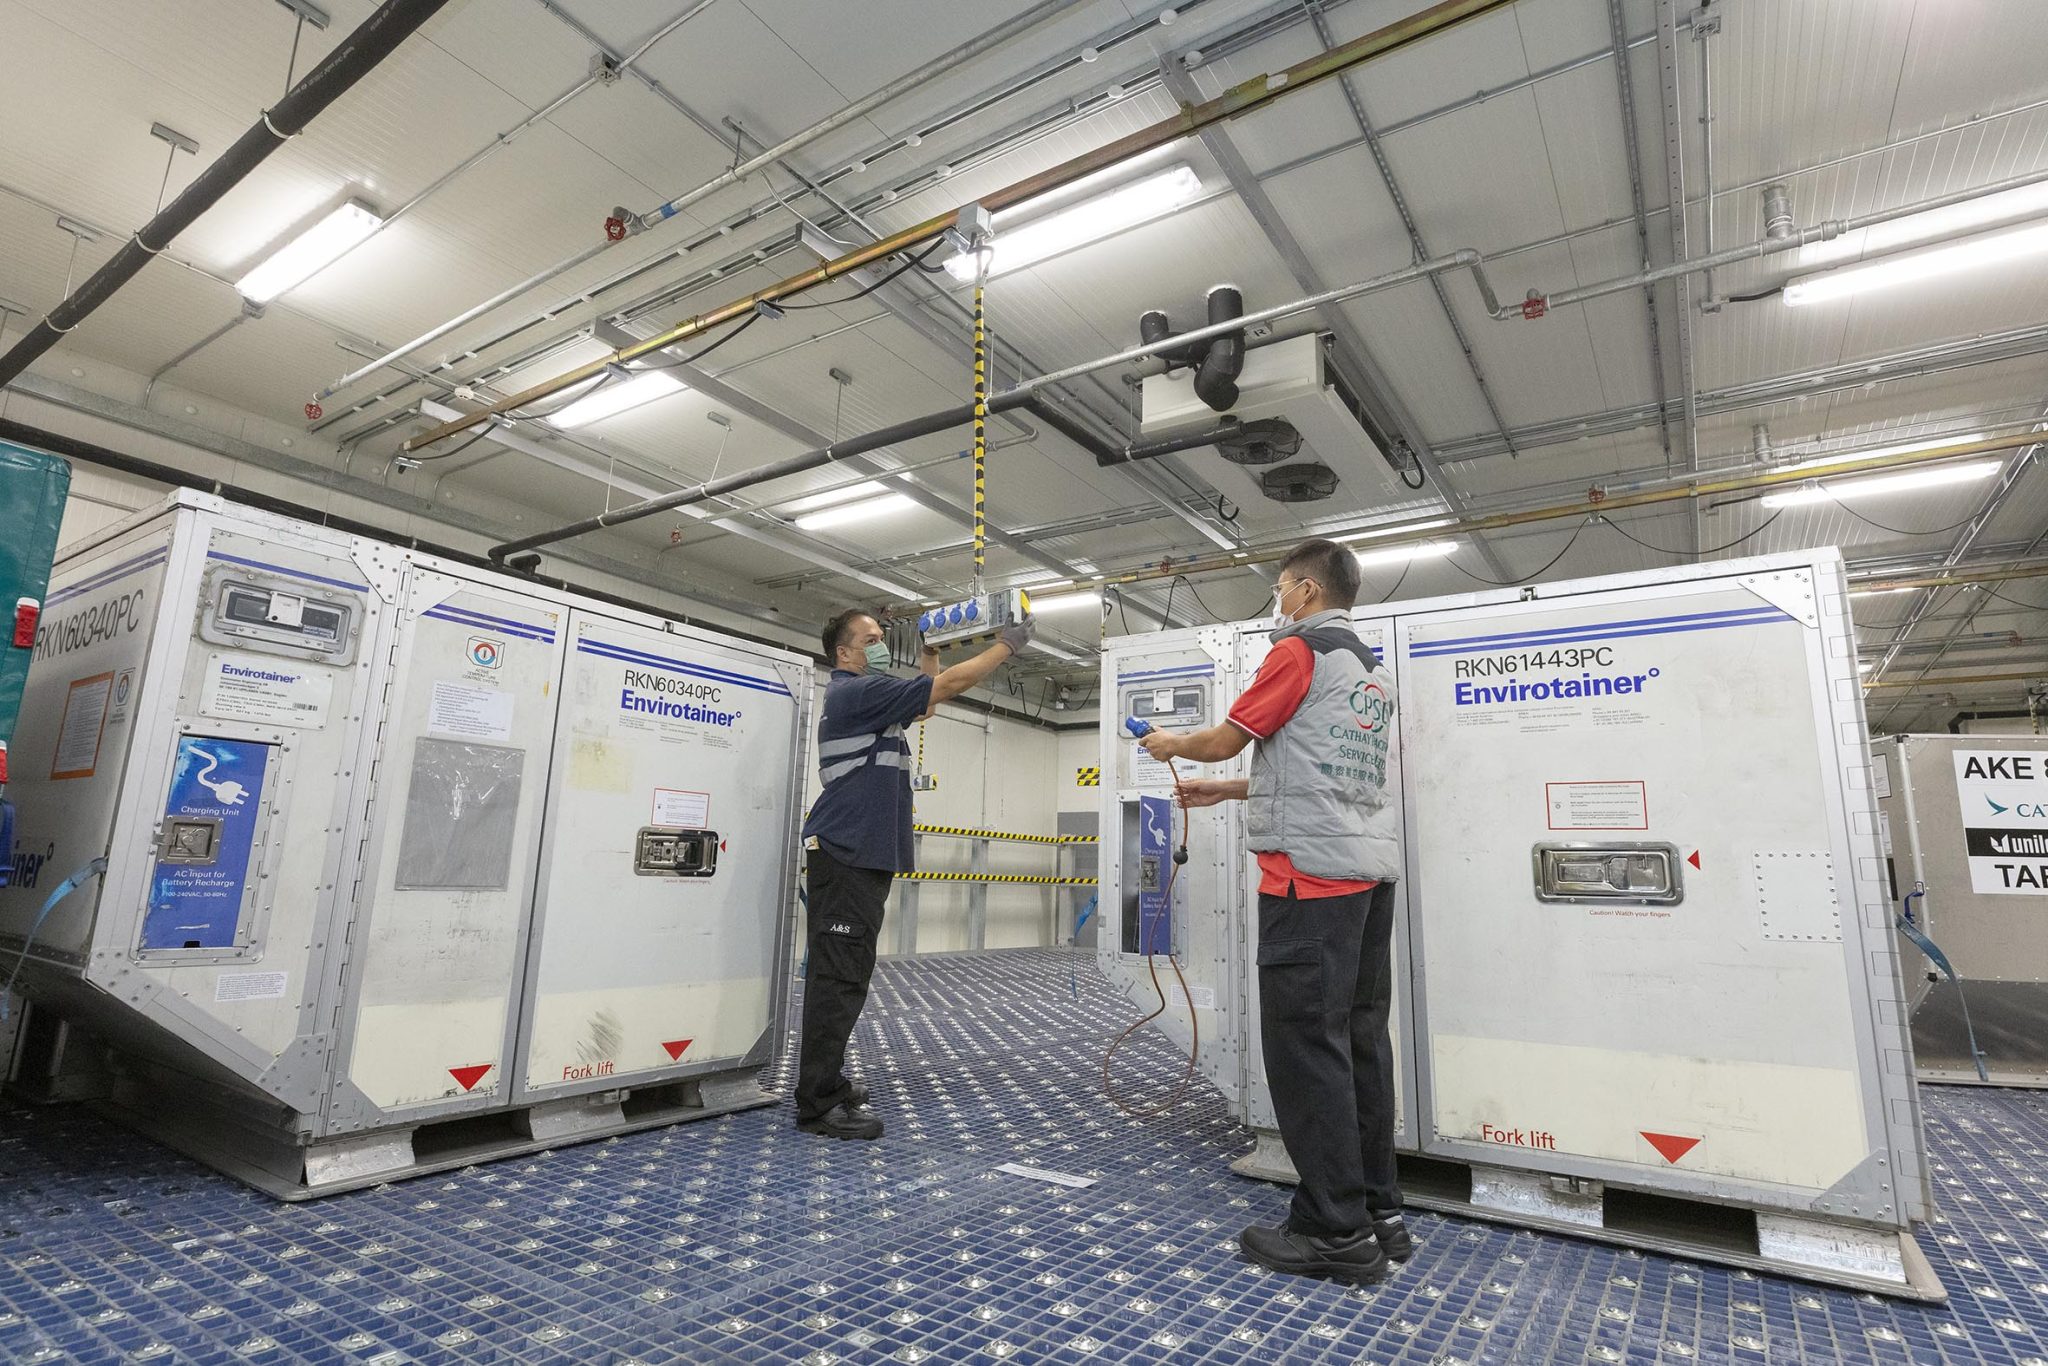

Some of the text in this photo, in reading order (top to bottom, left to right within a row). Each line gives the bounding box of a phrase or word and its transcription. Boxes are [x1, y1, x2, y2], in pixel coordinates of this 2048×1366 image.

[32, 589, 144, 663] RKN60340PC
[1455, 647, 1613, 678] RKN61443PC
[624, 669, 722, 703] RKN60340PC
[1964, 756, 2034, 779] AKE
[181, 805, 240, 816] Charging Unit
[174, 870, 187, 878] AC
[189, 869, 212, 880] Input
[195, 880, 235, 888] Recharge
[563, 1060, 614, 1080] Fork lift
[1482, 1124, 1556, 1150] Fork lift
